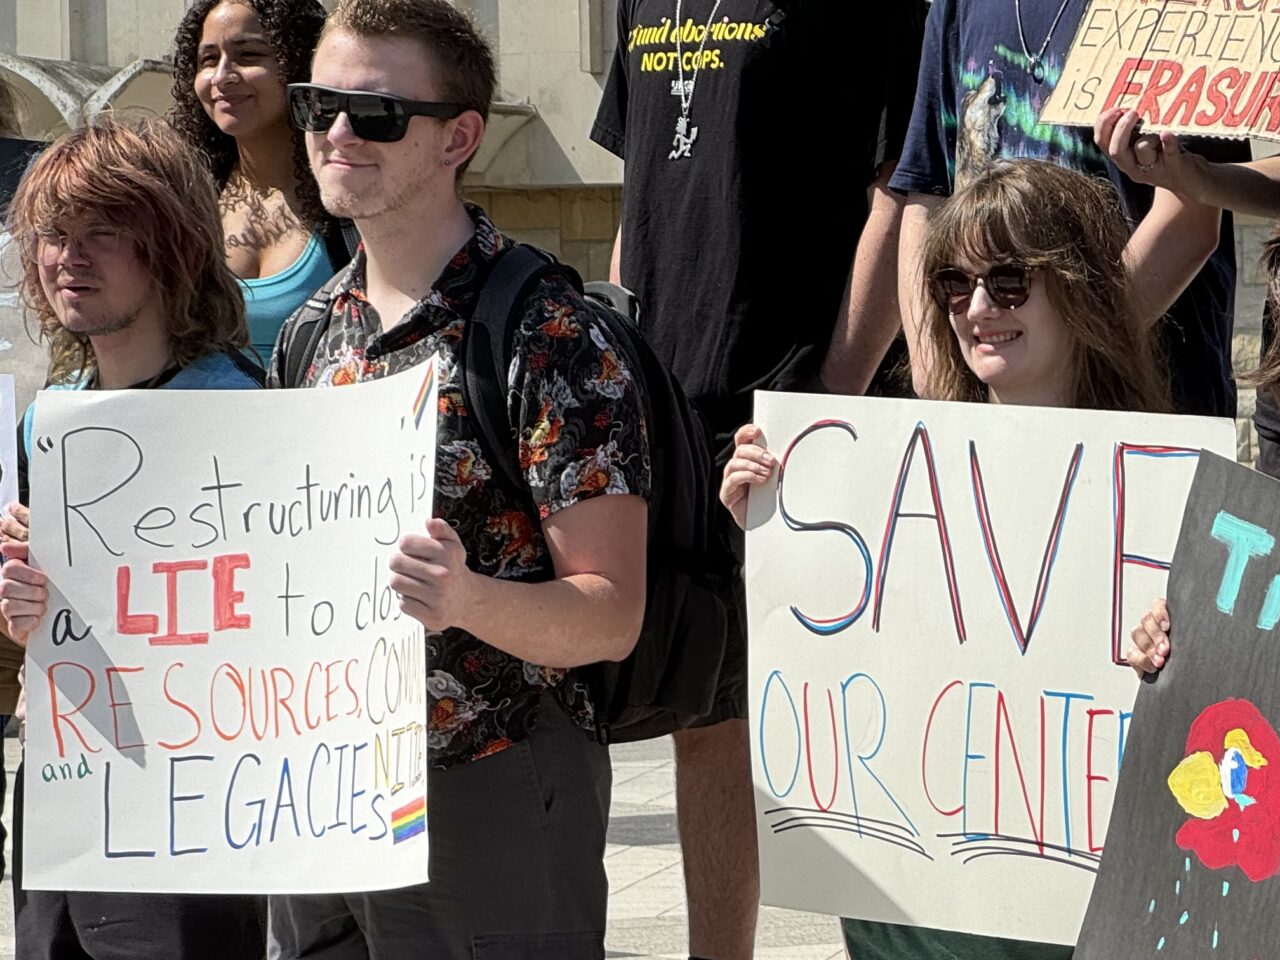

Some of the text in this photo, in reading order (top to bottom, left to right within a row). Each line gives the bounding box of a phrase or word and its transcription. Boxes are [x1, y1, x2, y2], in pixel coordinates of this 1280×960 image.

[641, 49, 724, 71] NOT COPS.
[1062, 68, 1102, 111] is
[778, 419, 1200, 666] SAVE
[51, 610, 92, 646] a
[116, 553, 251, 645] LIE
[277, 562, 335, 636] to
[41, 742, 388, 858] and LEGACIES
[760, 670, 919, 838] OUR
